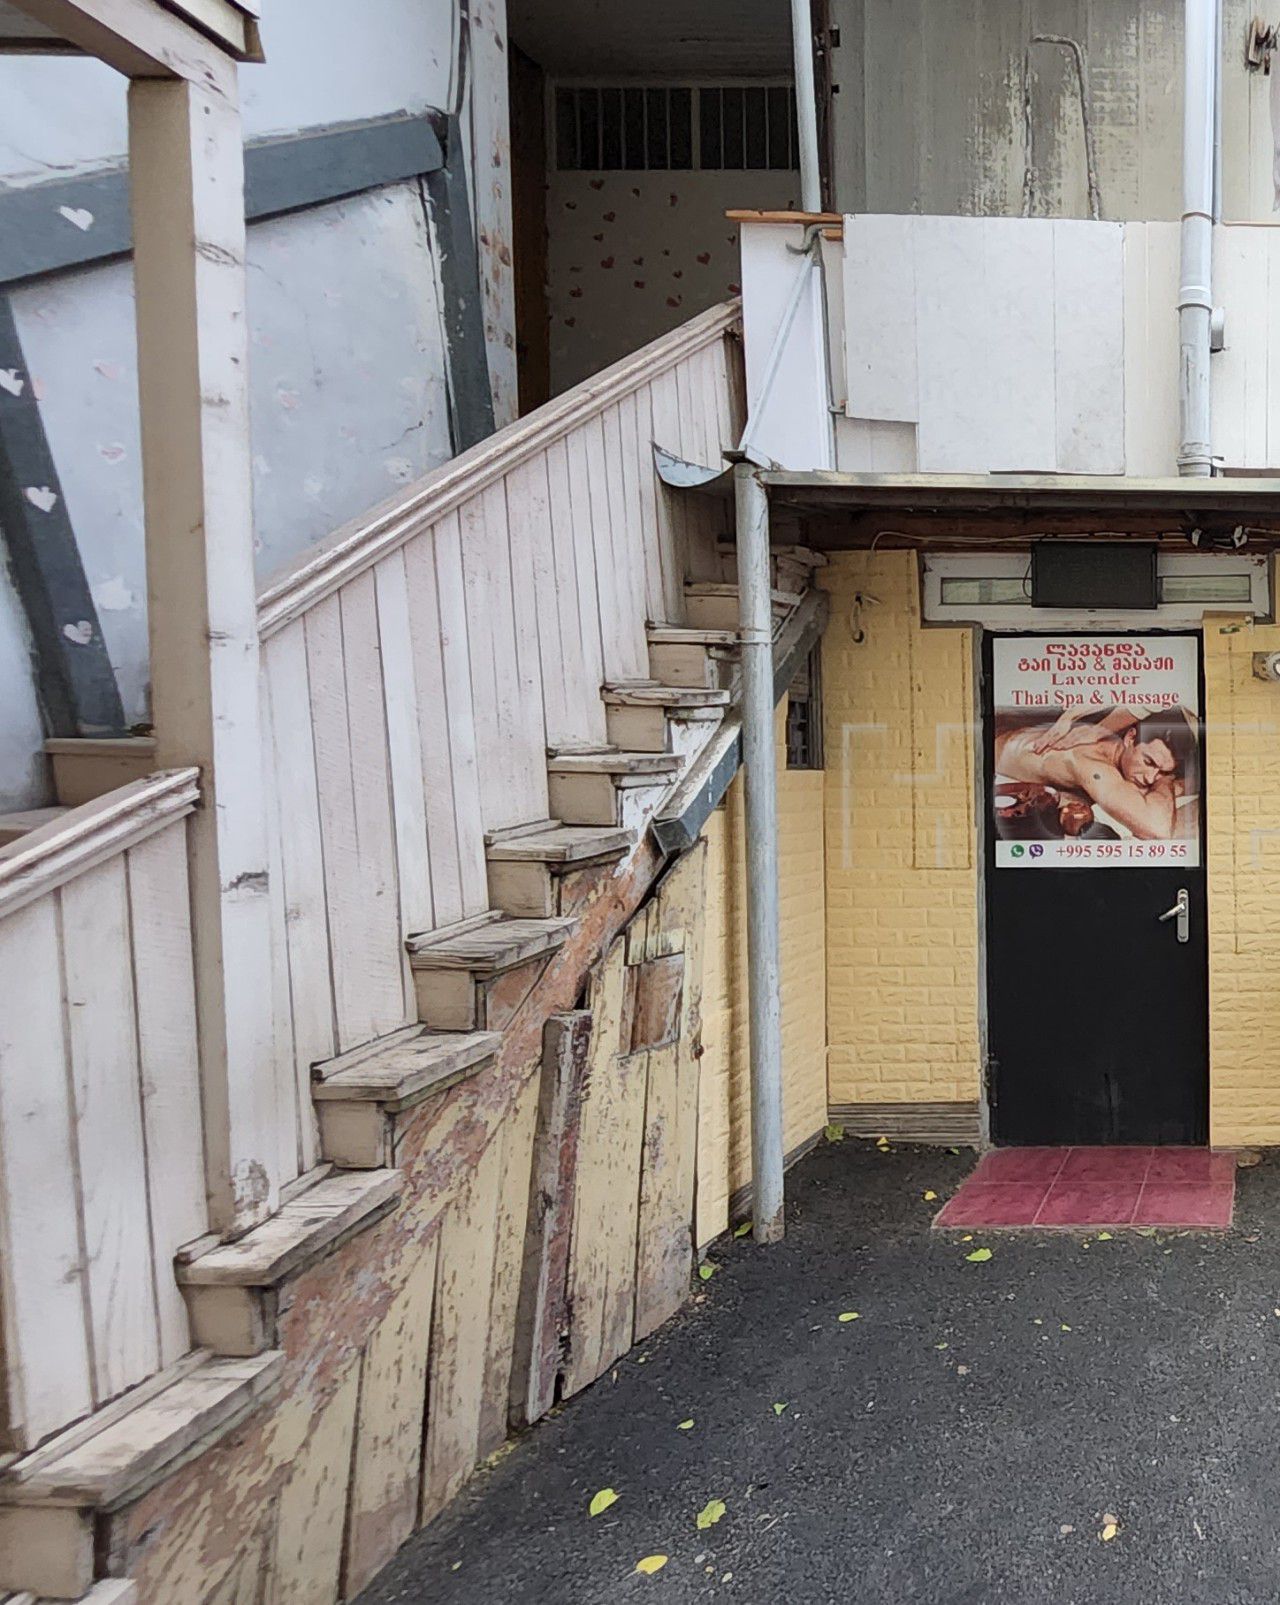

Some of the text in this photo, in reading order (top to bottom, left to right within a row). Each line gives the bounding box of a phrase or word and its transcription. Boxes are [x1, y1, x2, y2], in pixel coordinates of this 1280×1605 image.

[1046, 643, 1145, 657] ლავანდა
[1057, 657, 1086, 671] სპა
[1093, 656, 1106, 671] &
[1112, 656, 1174, 671] მასაჟი
[1051, 673, 1141, 686] Lavender
[1012, 690, 1179, 708] Thai Spa & Massage
[1056, 844, 1187, 858] +995 595 15 89 55
